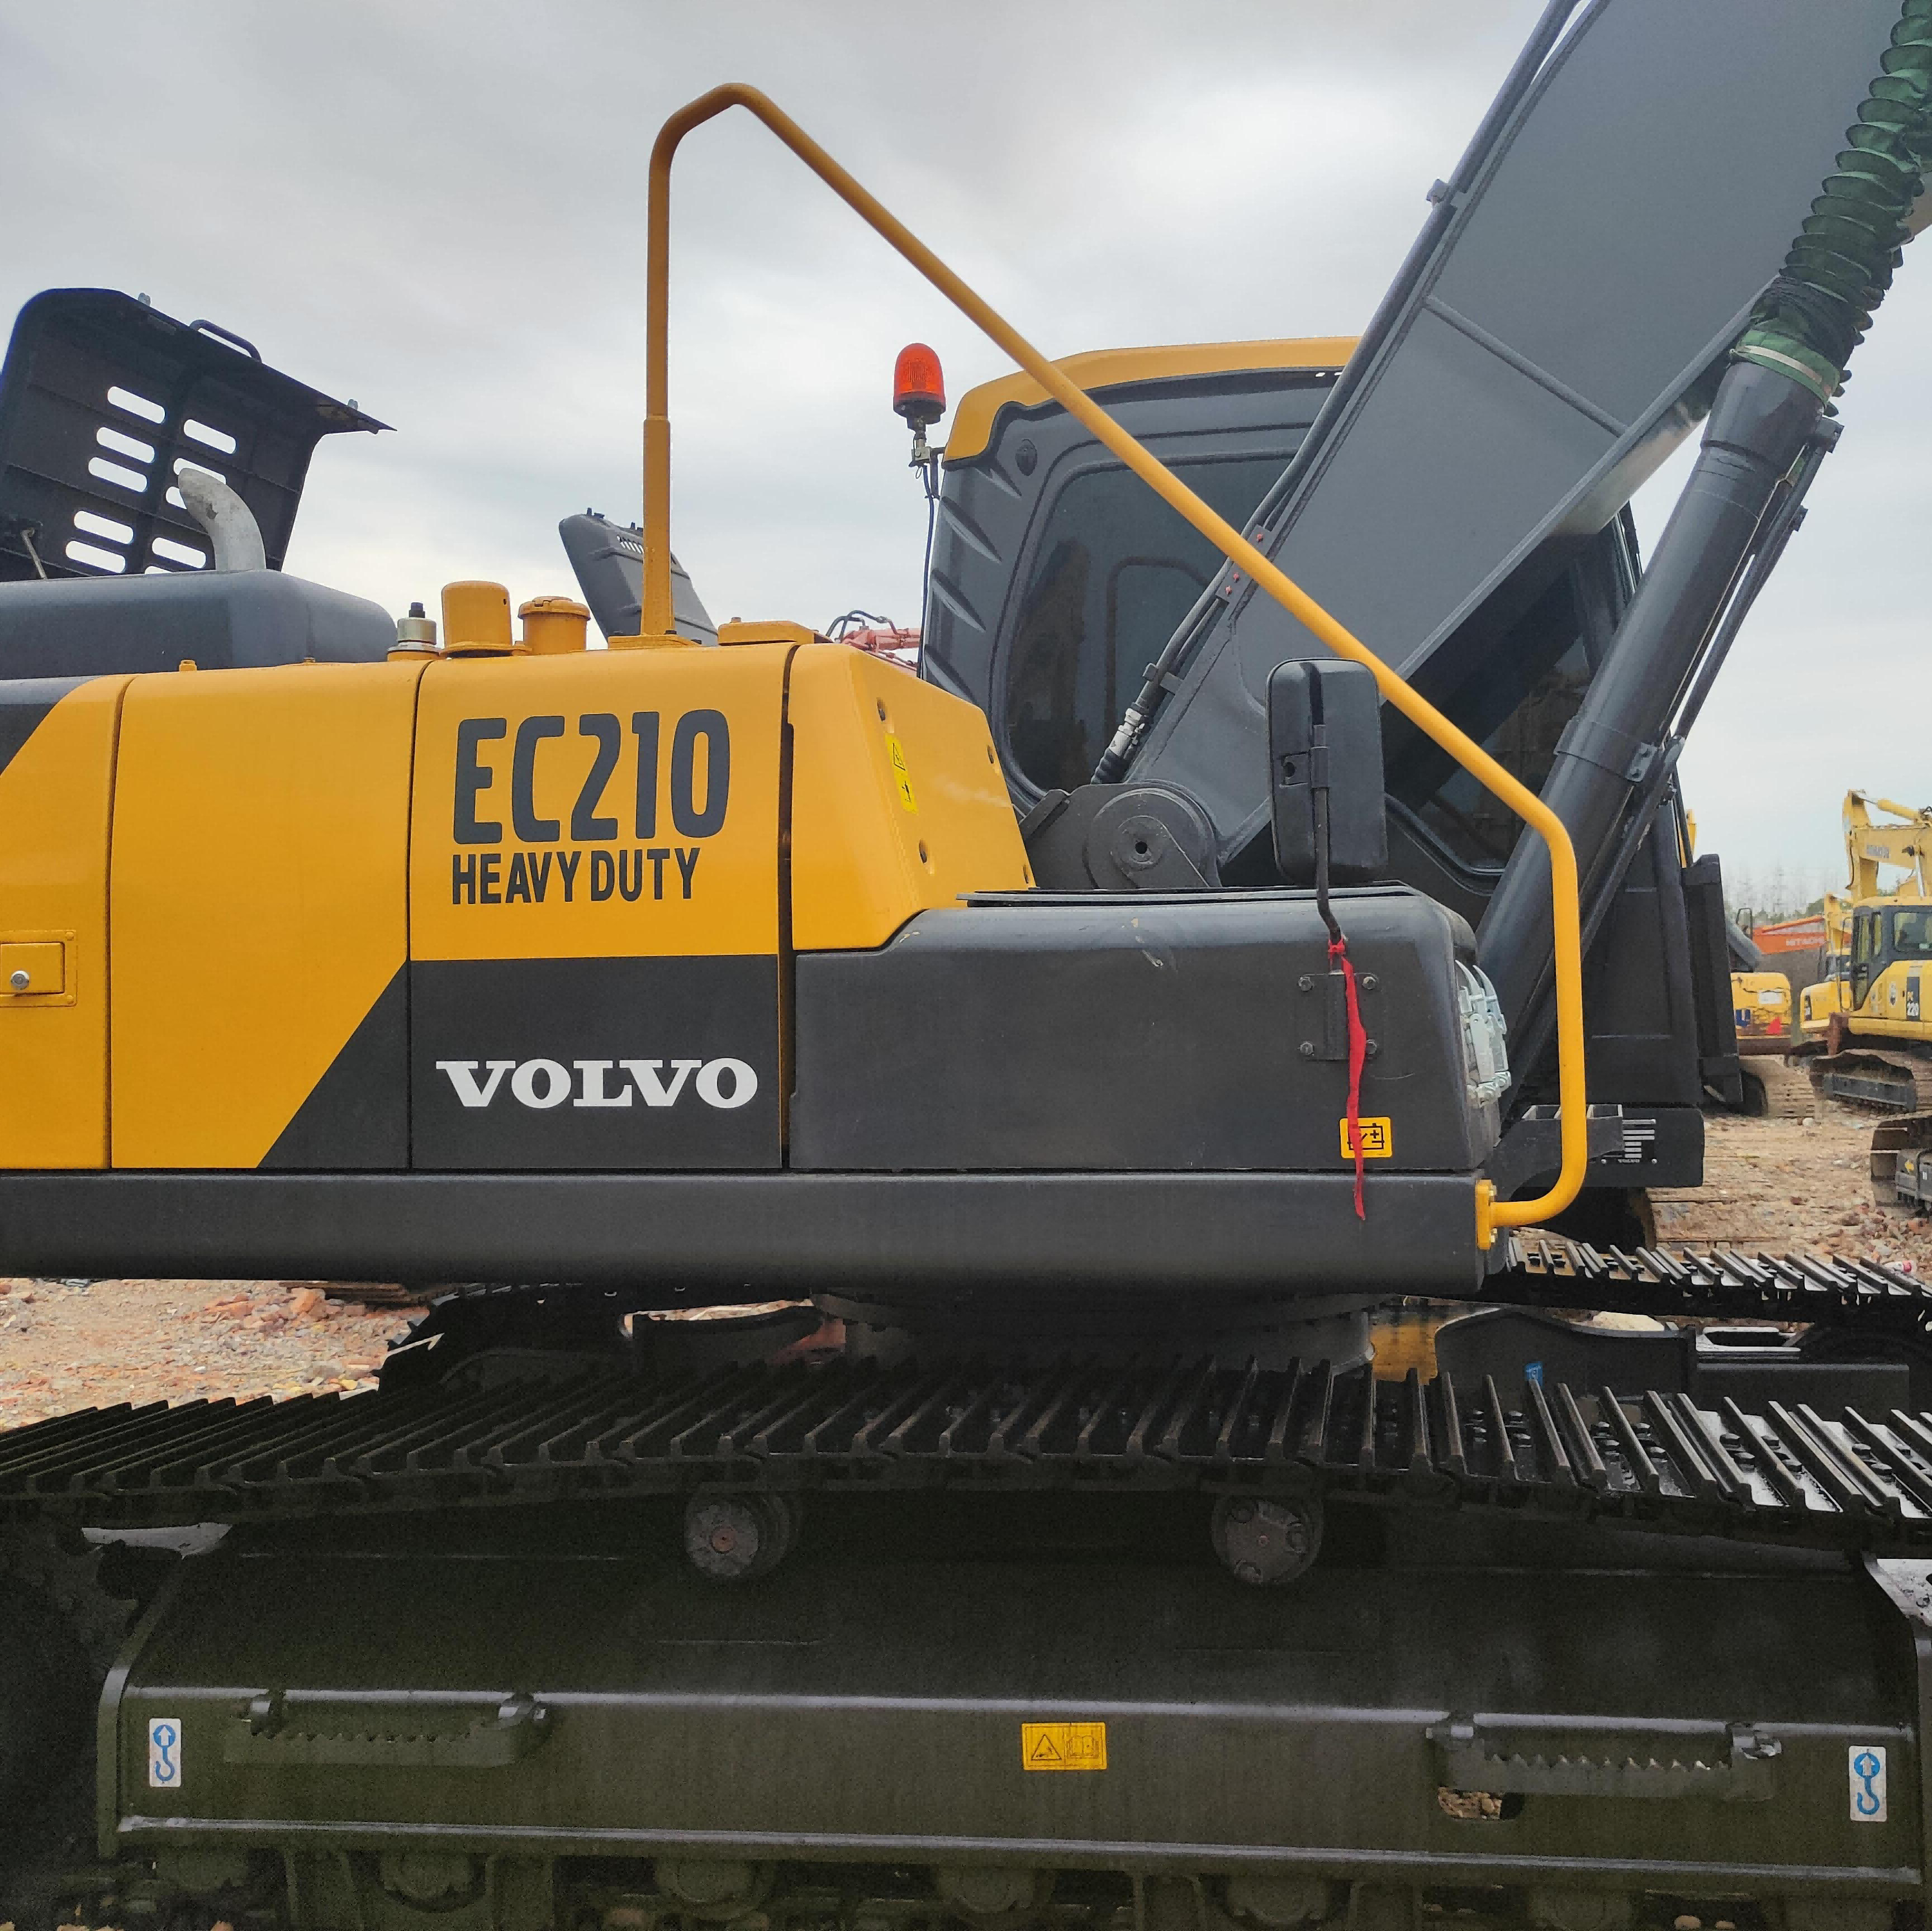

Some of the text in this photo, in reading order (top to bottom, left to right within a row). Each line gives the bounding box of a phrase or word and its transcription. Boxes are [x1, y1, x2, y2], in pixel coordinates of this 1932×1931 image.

[453, 709, 730, 845] EC210
[452, 847, 700, 905] HEAVY DUTY
[435, 1058, 758, 1109] VOLVO
